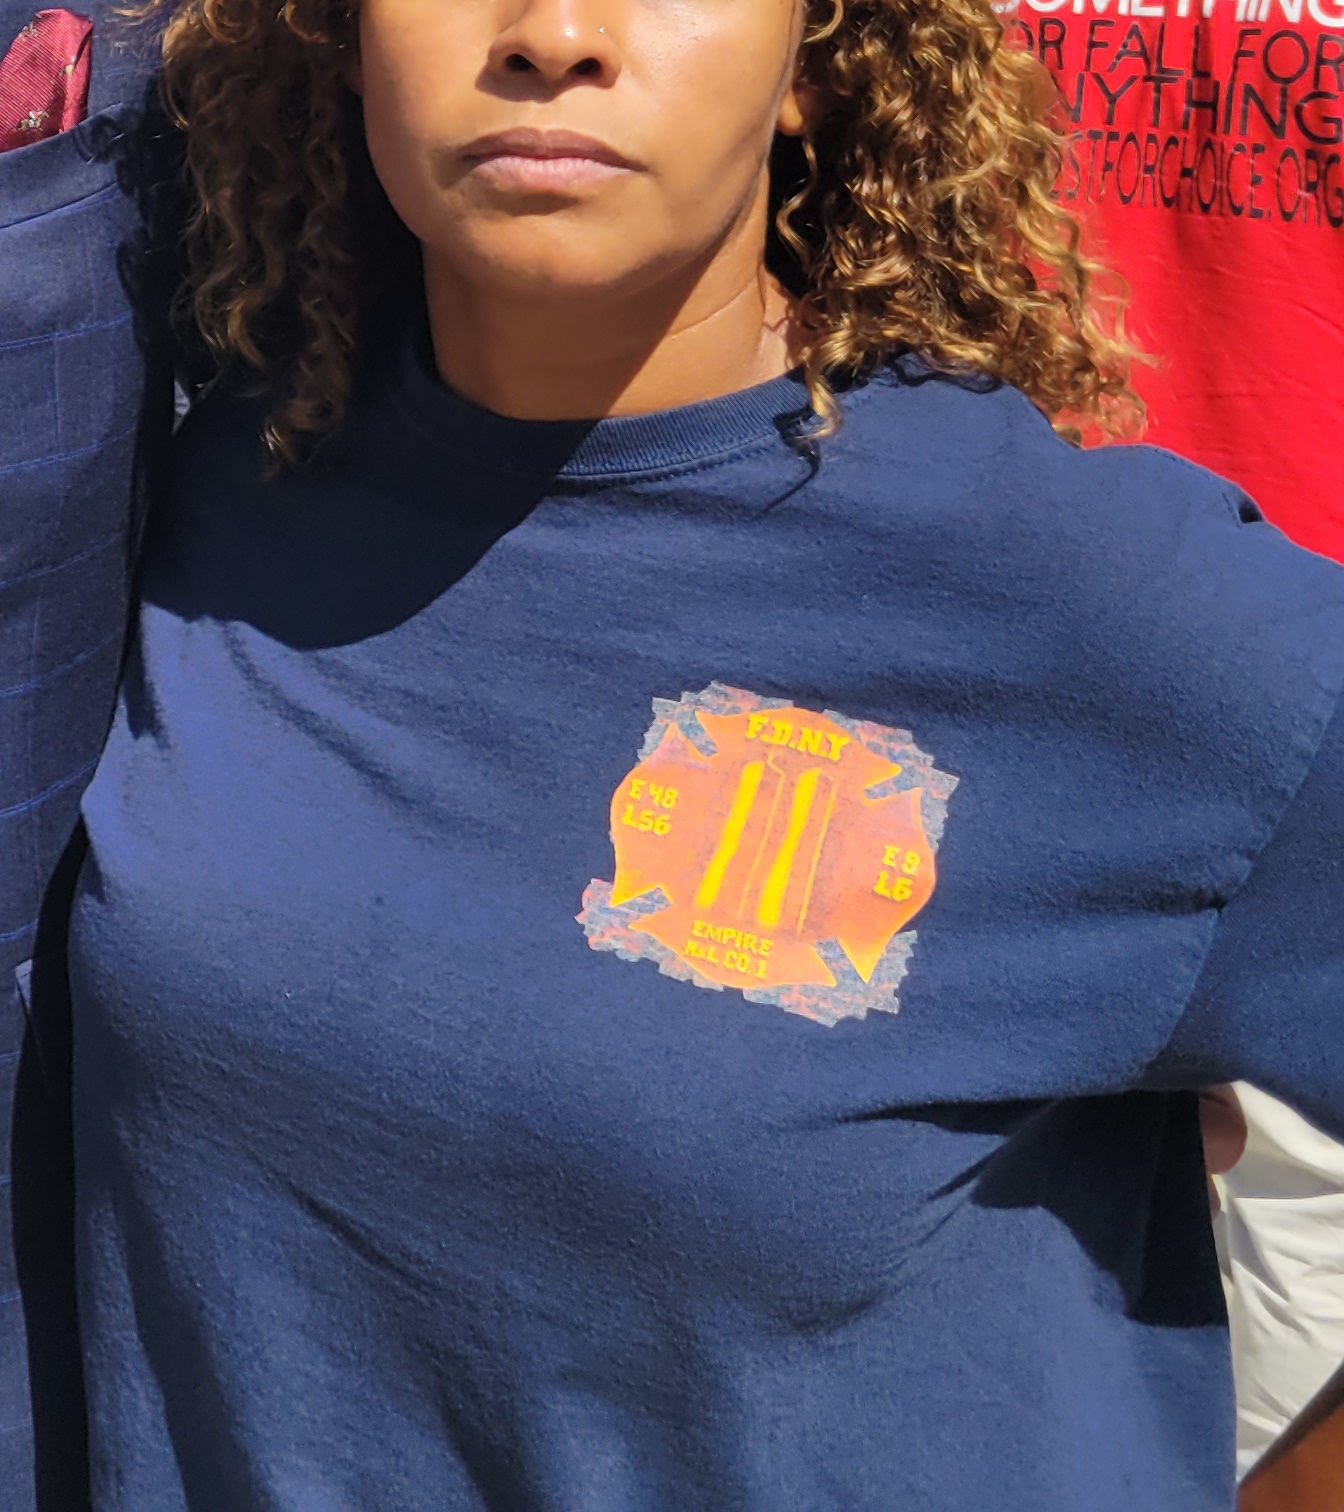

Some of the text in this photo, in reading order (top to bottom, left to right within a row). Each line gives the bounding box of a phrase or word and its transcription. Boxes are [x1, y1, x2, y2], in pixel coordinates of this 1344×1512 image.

[1085, 20, 1211, 79] FALL
[1229, 29, 1344, 92] FOR
[1050, 71, 1344, 145] NYTHING
[1049, 128, 1344, 229] STFORCHOICE.ORG
[692, 919, 773, 957] EMPIRE
